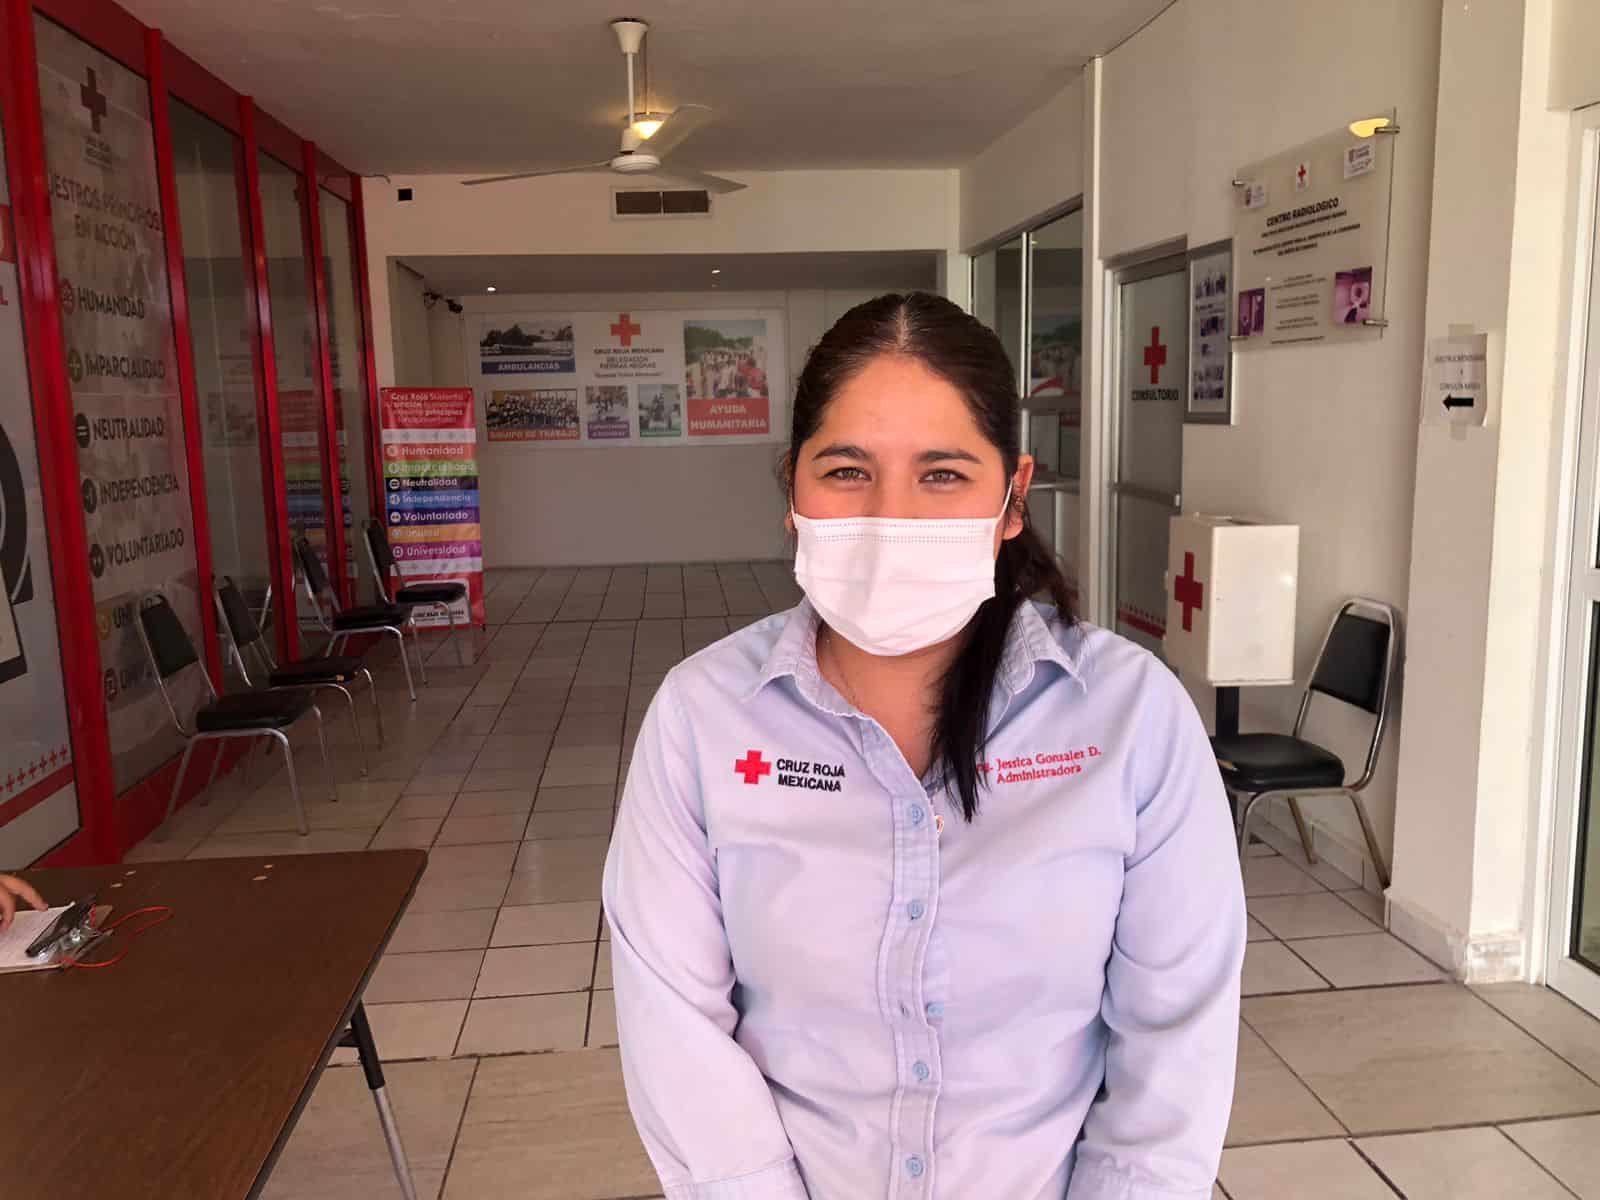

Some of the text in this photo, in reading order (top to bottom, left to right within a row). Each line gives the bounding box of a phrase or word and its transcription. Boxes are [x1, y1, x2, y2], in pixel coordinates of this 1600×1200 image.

[48, 174, 99, 210] UESTROS
[74, 213, 90, 238] EN
[1266, 211, 1291, 228] CENTRO
[77, 287, 145, 319] HUMANIDAD
[85, 353, 166, 379] IMPARCIALIDAD
[1132, 388, 1179, 401] CONSULTORIO
[709, 404, 747, 414] AYUDA
[93, 416, 164, 441] NEUTRALIDAD
[690, 419, 767, 430] HUMANITARIA
[401, 447, 464, 456] Humanidad
[99, 474, 180, 505] INDEPENDENCIA
[402, 478, 458, 487] Neutralidad
[403, 511, 468, 521] Voluntariado
[106, 527, 184, 568] VOLUNTARIADO
[776, 758, 846, 778] CRUZ ROJA
[996, 756, 1033, 771] Jessica
[1087, 745, 1102, 757] D.
[777, 774, 841, 792] MEXICANA
[997, 764, 1082, 784] Administradora
